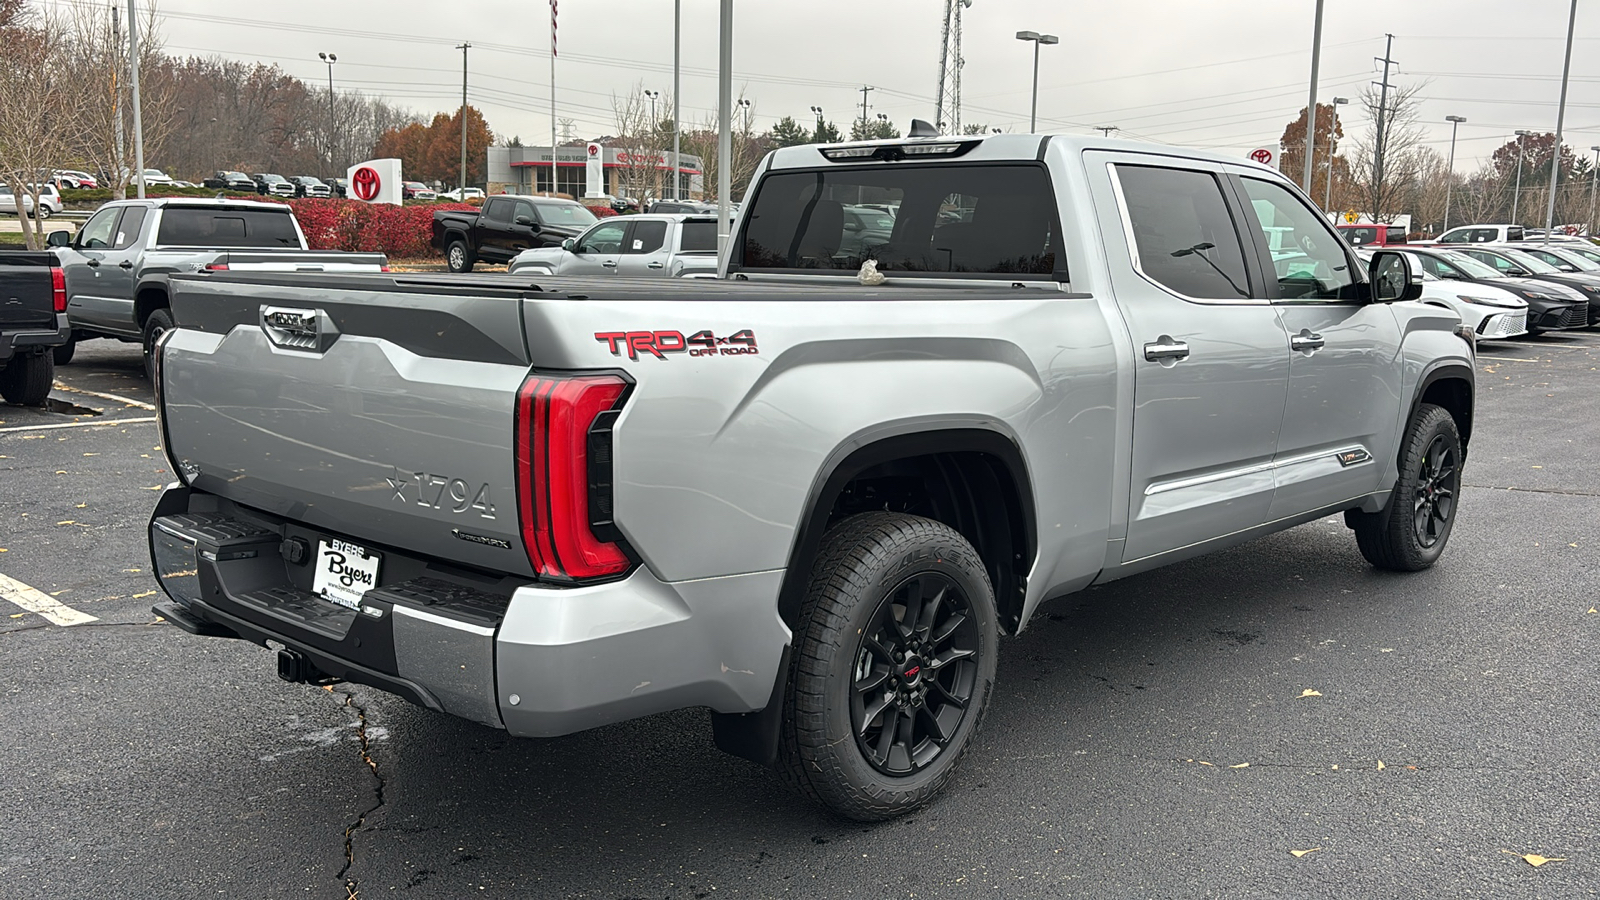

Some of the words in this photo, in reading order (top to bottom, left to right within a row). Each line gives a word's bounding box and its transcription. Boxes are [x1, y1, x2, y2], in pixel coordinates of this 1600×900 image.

[594, 331, 688, 362] TRD
[689, 348, 718, 357] OFF
[720, 346, 759, 357] ROAD
[414, 471, 496, 520] 1794
[332, 538, 366, 558] BYERS
[324, 550, 372, 587] Byers
[904, 665, 920, 677] TRD
